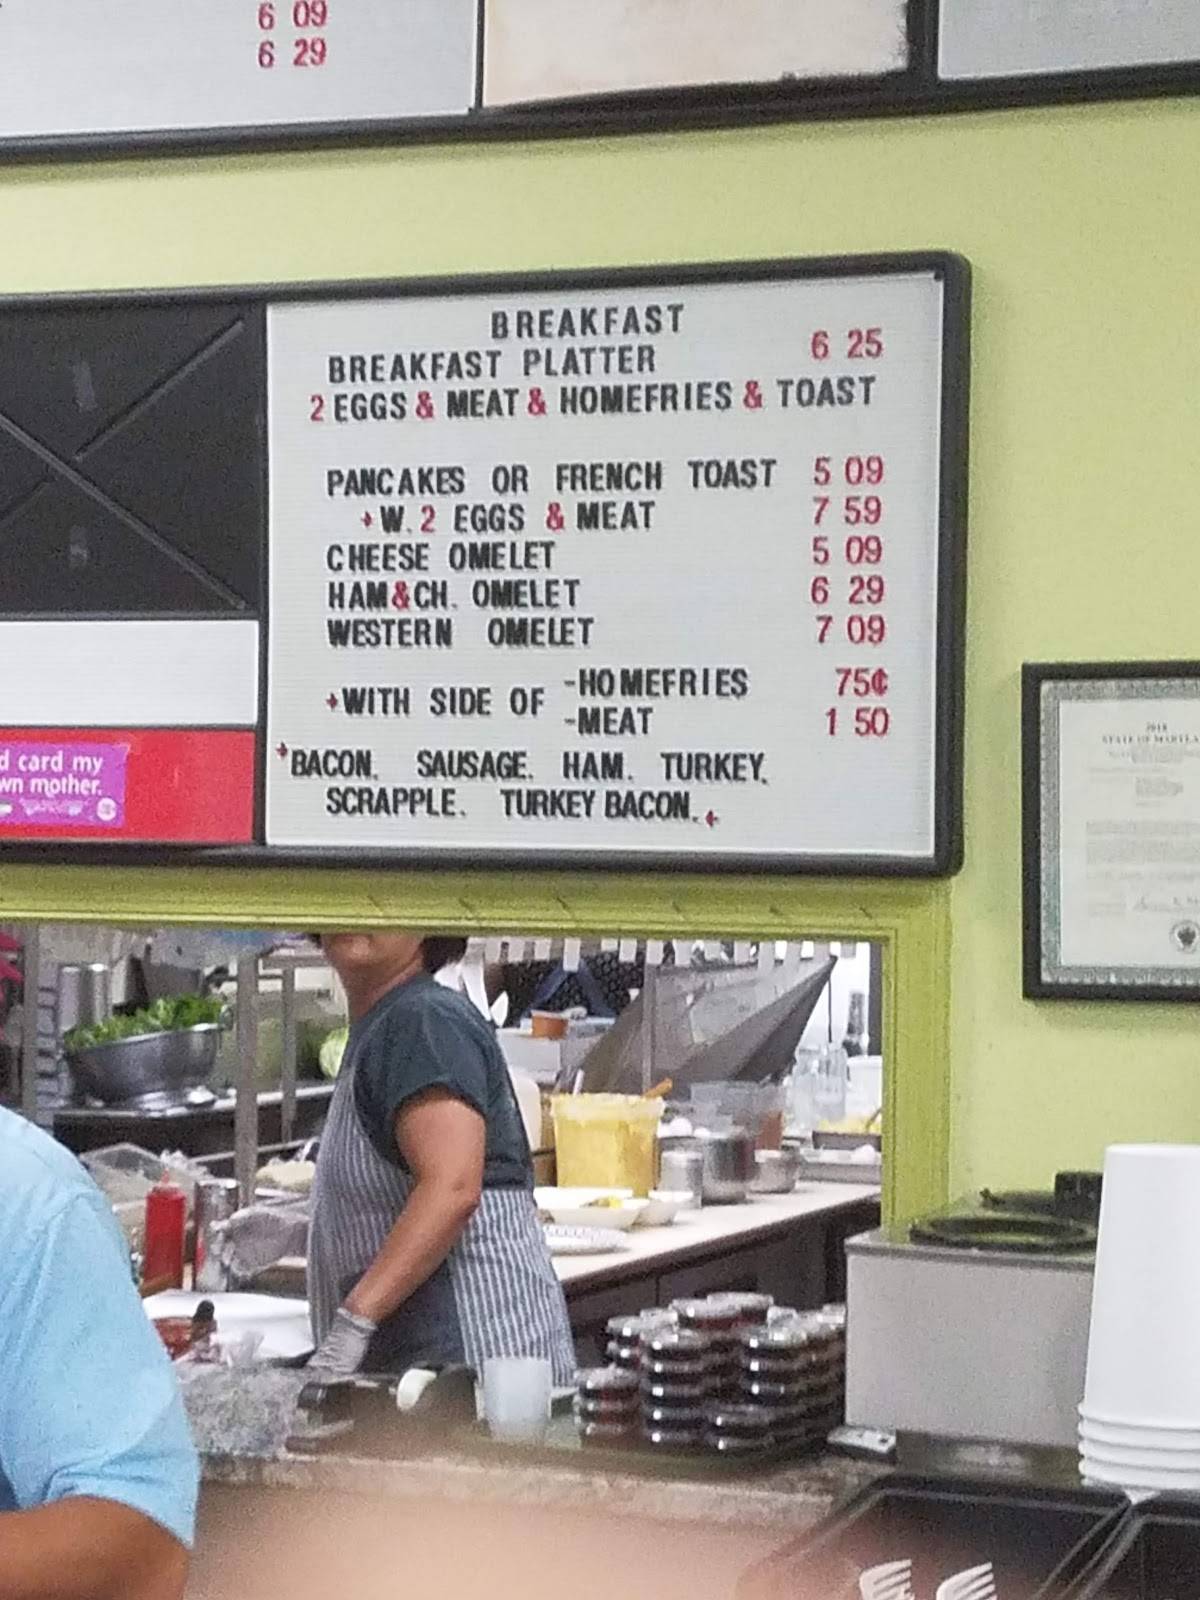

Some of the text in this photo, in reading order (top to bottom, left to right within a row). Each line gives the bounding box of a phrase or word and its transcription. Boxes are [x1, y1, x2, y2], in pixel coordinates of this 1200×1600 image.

[257, 0, 328, 31] 6 09
[257, 37, 328, 69] 6 29
[491, 303, 685, 341] BREAKFAST
[328, 327, 884, 385] BREAKFAST PLATTER 6 25
[310, 375, 877, 425] 2 EGGS & MEAT & HOMEFRIES & TOAST
[326, 455, 884, 498] PANCAKES OR FRENCH TOAST 5 09
[420, 503, 436, 534] 2
[453, 502, 525, 536] EGGS
[545, 501, 566, 533] &
[576, 499, 656, 532] MEAT
[812, 495, 831, 526] 7
[843, 495, 882, 526] 59
[326, 534, 883, 575] CHEESE OMELET 5 09
[471, 578, 581, 611] OMELET
[810, 575, 830, 606] 6
[848, 574, 885, 606] 29
[326, 614, 886, 650] WESTERN OMELET 7 09
[835, 667, 889, 698] 75¢
[429, 686, 492, 718] SIDE
[509, 686, 545, 718] OF
[825, 707, 837, 737] 1
[854, 706, 890, 738] 50
[18, 750, 63, 772] card
[72, 755, 103, 777] my
[30, 772, 102, 797] mother.
[499, 787, 597, 820] TURKEY
